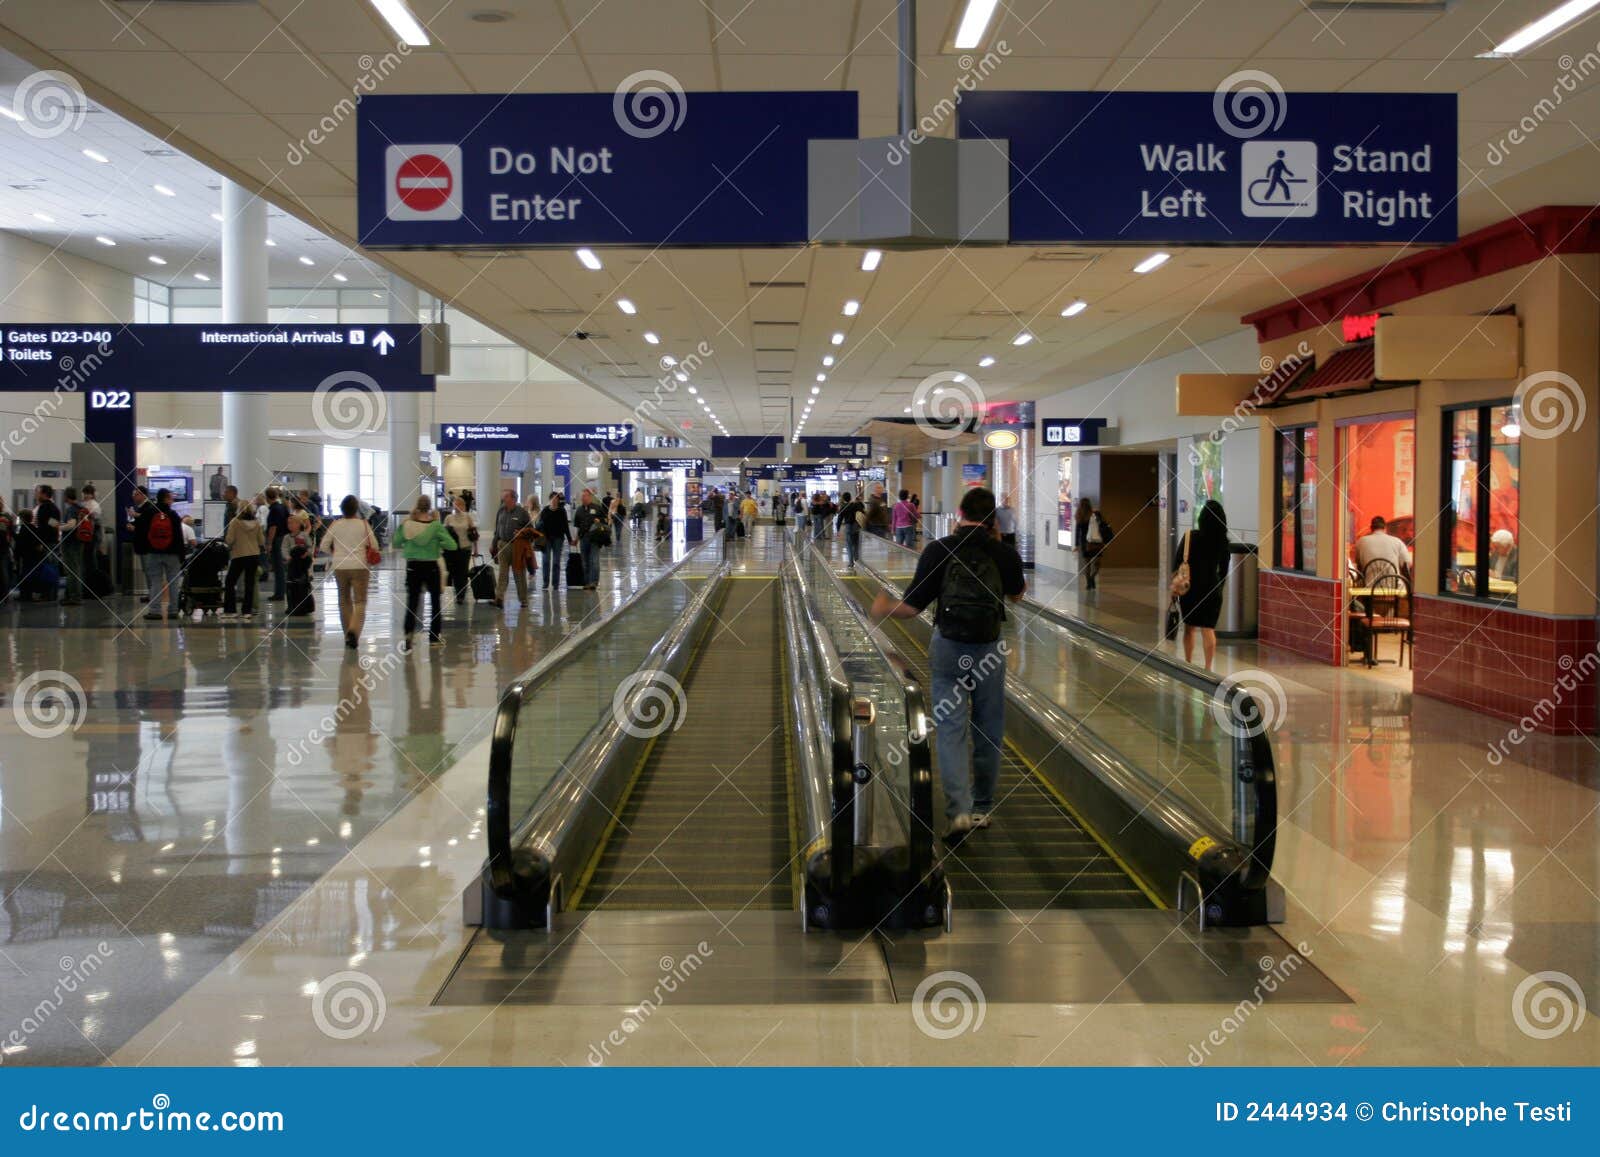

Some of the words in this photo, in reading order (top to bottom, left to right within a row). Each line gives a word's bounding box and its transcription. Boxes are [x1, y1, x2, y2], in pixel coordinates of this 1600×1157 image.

[489, 147, 537, 175] Do
[550, 147, 613, 175] Not
[1140, 144, 1226, 172] Walk
[1333, 144, 1431, 173] Stand
[490, 193, 581, 221] Enter
[1141, 190, 1206, 217] Left
[1343, 191, 1432, 226] Right
[8, 331, 48, 343] Gates
[51, 331, 112, 343] D23-D40
[202, 331, 289, 343] International
[291, 331, 344, 343] Arrivals
[8, 349, 53, 361] Toilets
[91, 391, 131, 408] D22
